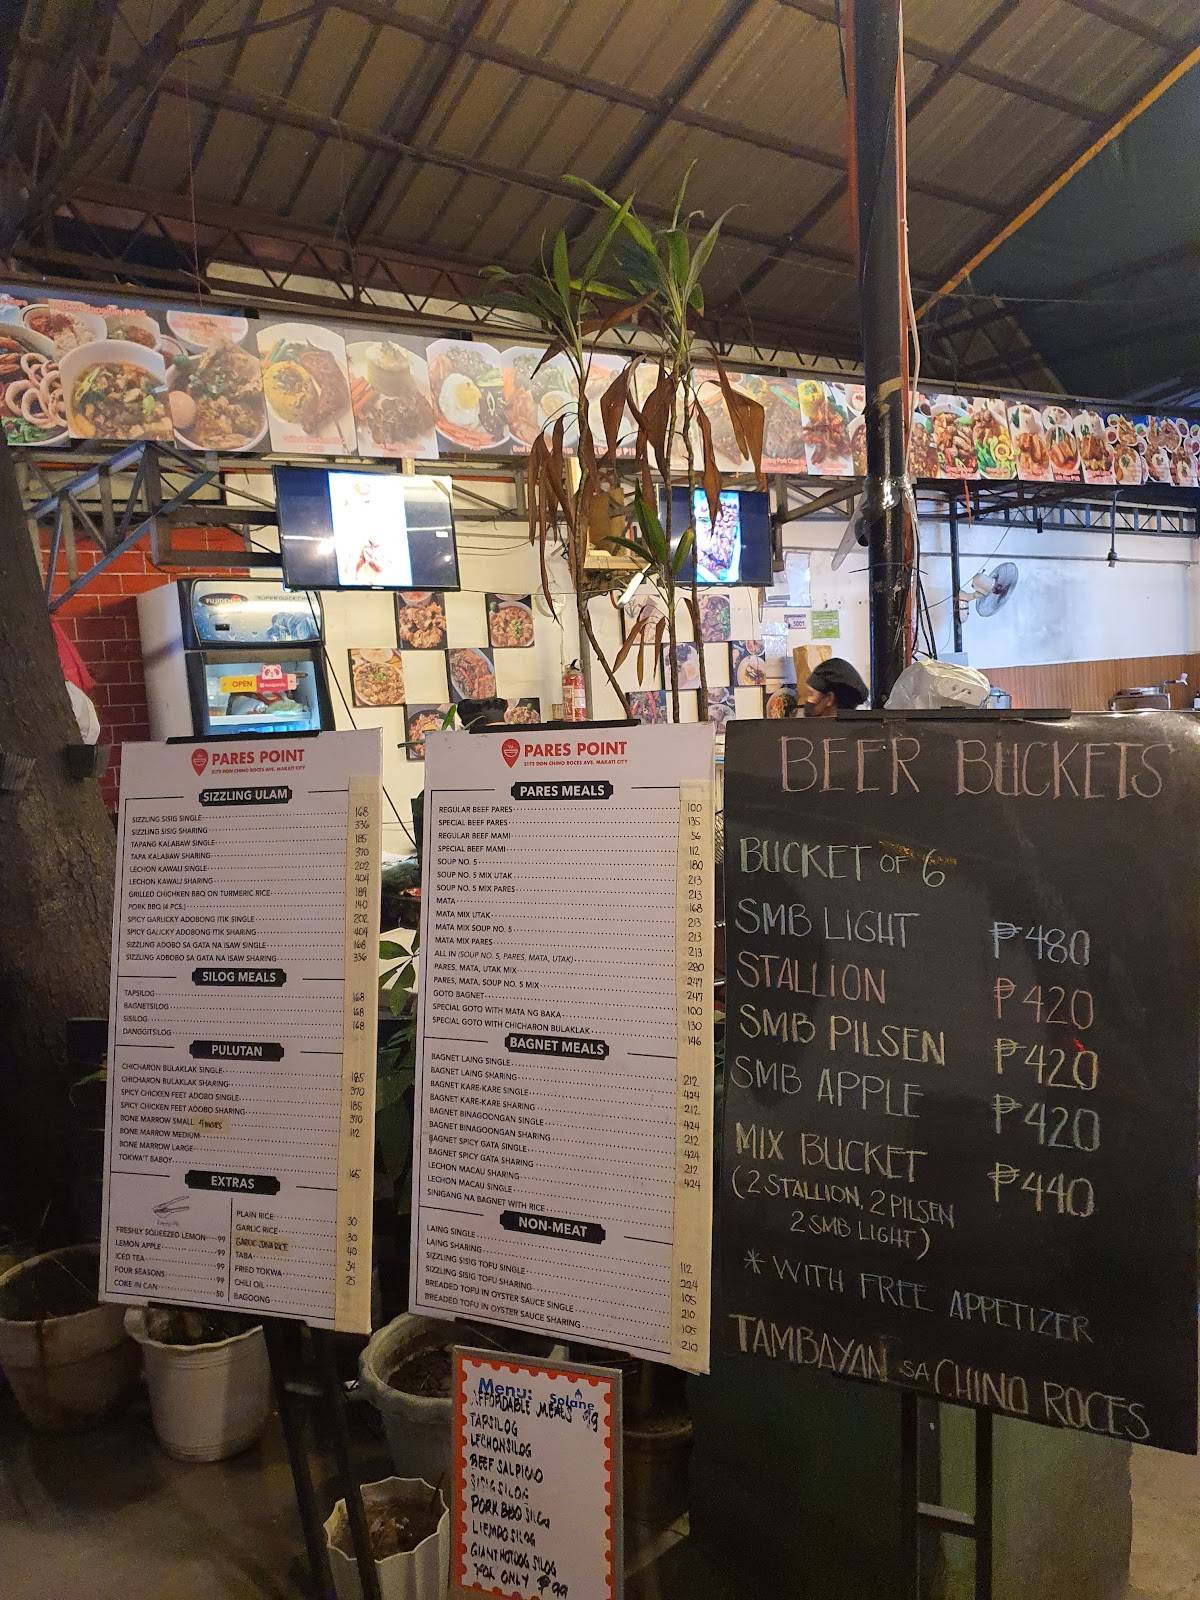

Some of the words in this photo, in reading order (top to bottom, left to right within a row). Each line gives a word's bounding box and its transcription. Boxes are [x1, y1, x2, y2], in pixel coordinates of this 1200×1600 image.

[525, 744, 571, 757] PARES
[578, 742, 627, 756] POINT
[212, 752, 254, 765] PARES
[260, 749, 304, 762] POINT
[779, 736, 921, 794] BEER
[955, 739, 1174, 799] BUCKETS
[203, 790, 251, 801] SIZZLING
[255, 789, 288, 799] ULAM
[520, 786, 558, 796] PARES
[562, 785, 604, 796] MEALS
[688, 804, 702, 812] 100
[690, 846, 699, 855] 112
[353, 861, 370, 870] 202
[690, 860, 703, 869] 180
[740, 837, 872, 881] BUCKET
[880, 854, 910, 873] OF
[922, 848, 945, 887] 6
[690, 904, 703, 912] 168
[735, 898, 812, 936] SMB
[825, 907, 920, 948] LIGHT
[202, 972, 235, 982] SILOG
[239, 972, 276, 982] MEALS
[687, 977, 702, 987] 247
[736, 951, 885, 1004] STALLION
[124, 1002, 169, 1010] BAGNETSILOG
[433, 1003, 459, 1011] SPECIAL
[688, 1021, 702, 1030] 130
[740, 1004, 815, 1043] SMB
[831, 1015, 945, 1066] PILSEN
[212, 1045, 262, 1056] PULUTAN
[510, 1037, 558, 1051] BAGNET
[562, 1042, 604, 1055] MEALS
[122, 1063, 161, 1071] CHICHARON
[431, 1067, 459, 1075] BAGNET
[485, 1072, 517, 1080] SHARING
[461, 1083, 501, 1093] KARE-KARE
[503, 1087, 528, 1096] SINGLE
[731, 1056, 802, 1094] SMB
[818, 1068, 924, 1117] APPLE
[215, 1107, 245, 1115] SHARING
[684, 1105, 700, 1115] 212
[736, 1122, 784, 1160] MIX
[801, 1133, 928, 1182] BUCKET
[429, 1162, 456, 1171] LECHON
[459, 1166, 485, 1175] MACAU
[488, 1170, 519, 1179] SHARING
[211, 1176, 255, 1189] EXTRAS
[348, 1217, 357, 1226] 30
[518, 1216, 588, 1237] NON-MEAT
[116, 1226, 143, 1234] FRESHLY
[145, 1229, 180, 1238] SQUEEZED
[451, 1228, 475, 1238] SINGLE
[235, 1265, 254, 1273] FRIED
[256, 1267, 282, 1276] TOKWA
[681, 1262, 692, 1274] 112
[234, 1293, 270, 1303] BAGOONG
[773, 1256, 843, 1292] WITH
[861, 1273, 934, 1312] FREE
[950, 1290, 1093, 1343] APPETIZER
[425, 1293, 458, 1304] BREADED
[460, 1299, 479, 1308] TOFU
[491, 1305, 518, 1317] OYSTER
[521, 1311, 544, 1321] SAUCE
[547, 1315, 580, 1328] SHARING
[680, 1341, 698, 1352] 210
[729, 1314, 889, 1382] TAMBAYAN
[935, 1359, 1028, 1414] CHINO
[1044, 1380, 1150, 1439] ROCES
[479, 1378, 532, 1400] Menu:
[550, 1393, 594, 1410] Solane
[471, 1494, 498, 1515] PORK
[471, 1542, 497, 1561] GIANT
[501, 1570, 528, 1588] ONLY
